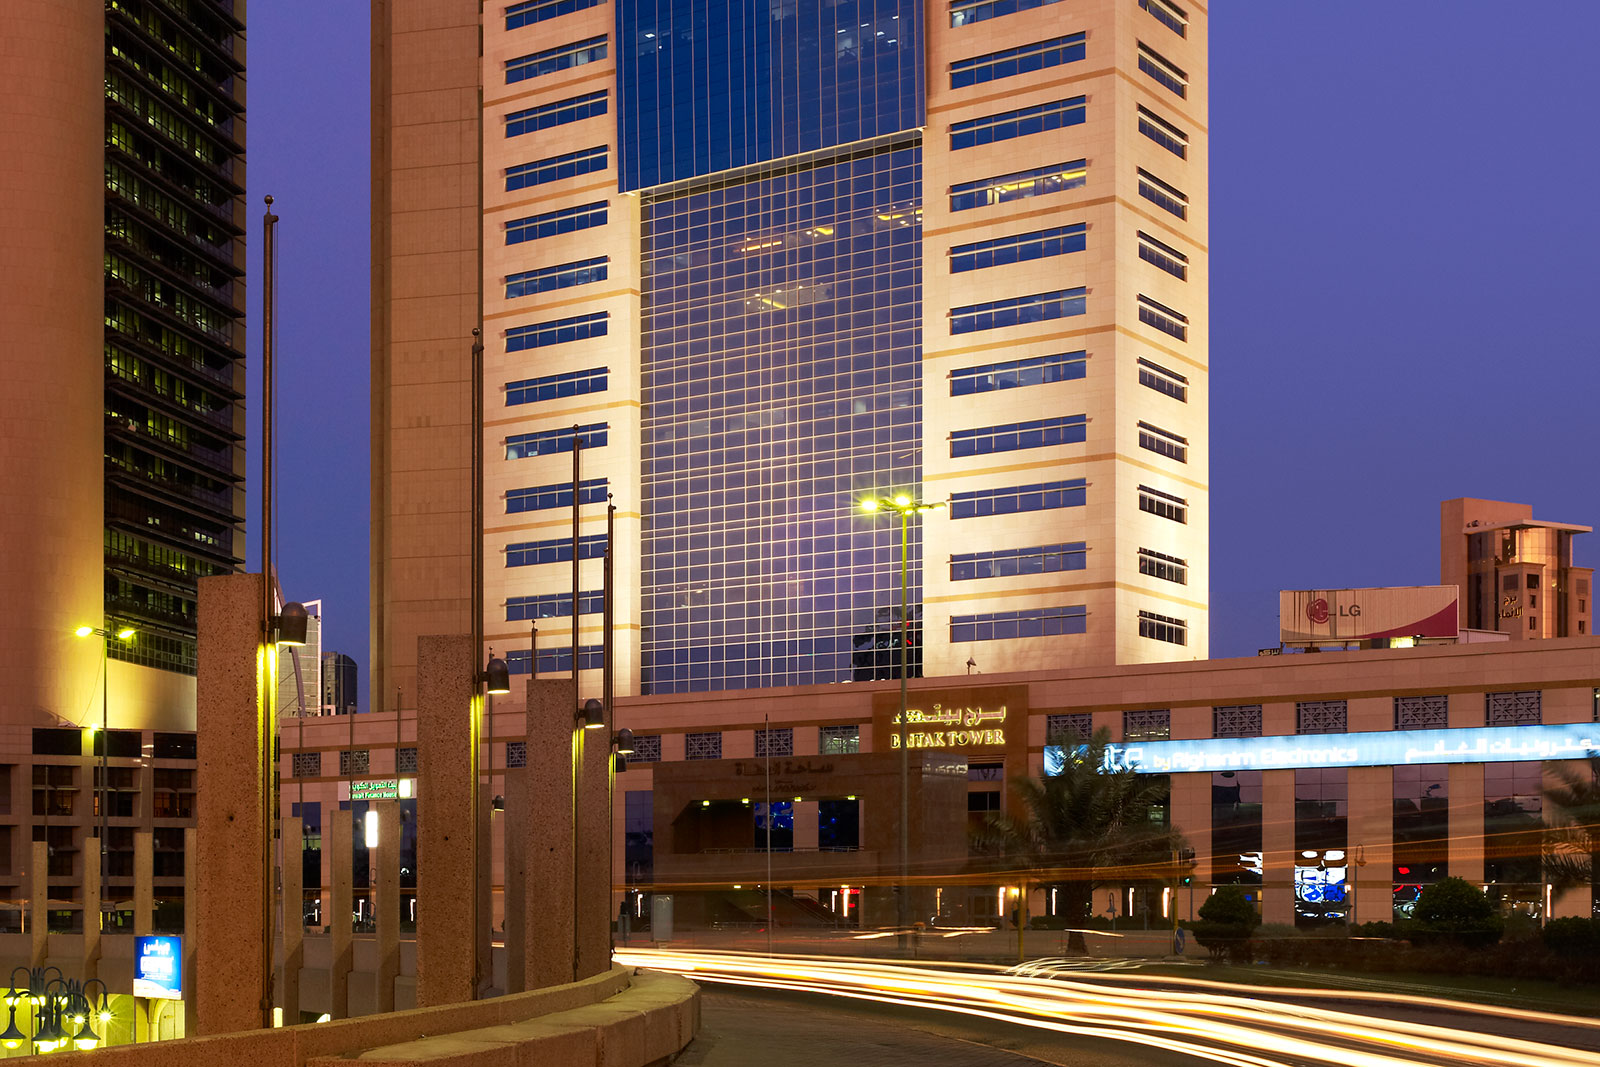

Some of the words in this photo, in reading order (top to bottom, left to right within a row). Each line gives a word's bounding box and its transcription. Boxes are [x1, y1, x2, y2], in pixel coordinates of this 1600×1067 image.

[1339, 605, 1361, 617] LG
[963, 706, 1006, 727] برج
[946, 729, 1006, 747] TOWER
[1153, 754, 1171, 771] by
[1172, 751, 1256, 771] Alghanim
[1260, 746, 1359, 764] Electronics
